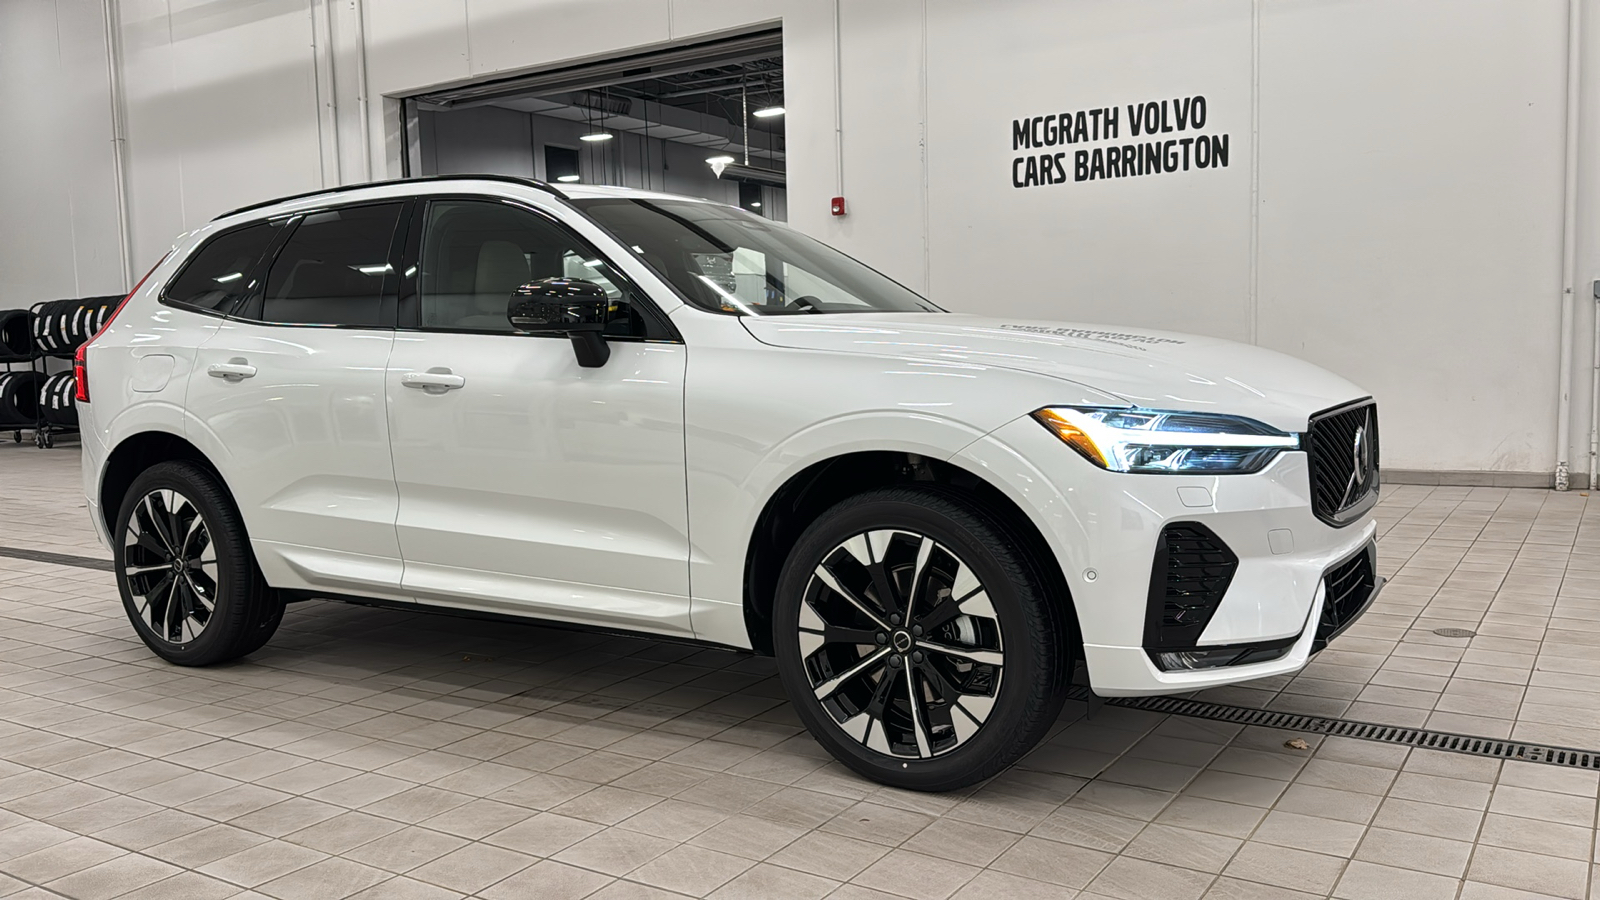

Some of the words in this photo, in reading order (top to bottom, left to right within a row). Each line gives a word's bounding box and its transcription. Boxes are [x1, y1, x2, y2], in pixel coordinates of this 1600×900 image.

[1012, 106, 1119, 151] MCGRATH
[1127, 95, 1207, 137] VOLVO
[1012, 152, 1067, 188] CARS
[1074, 133, 1229, 182] BARRINGTON
